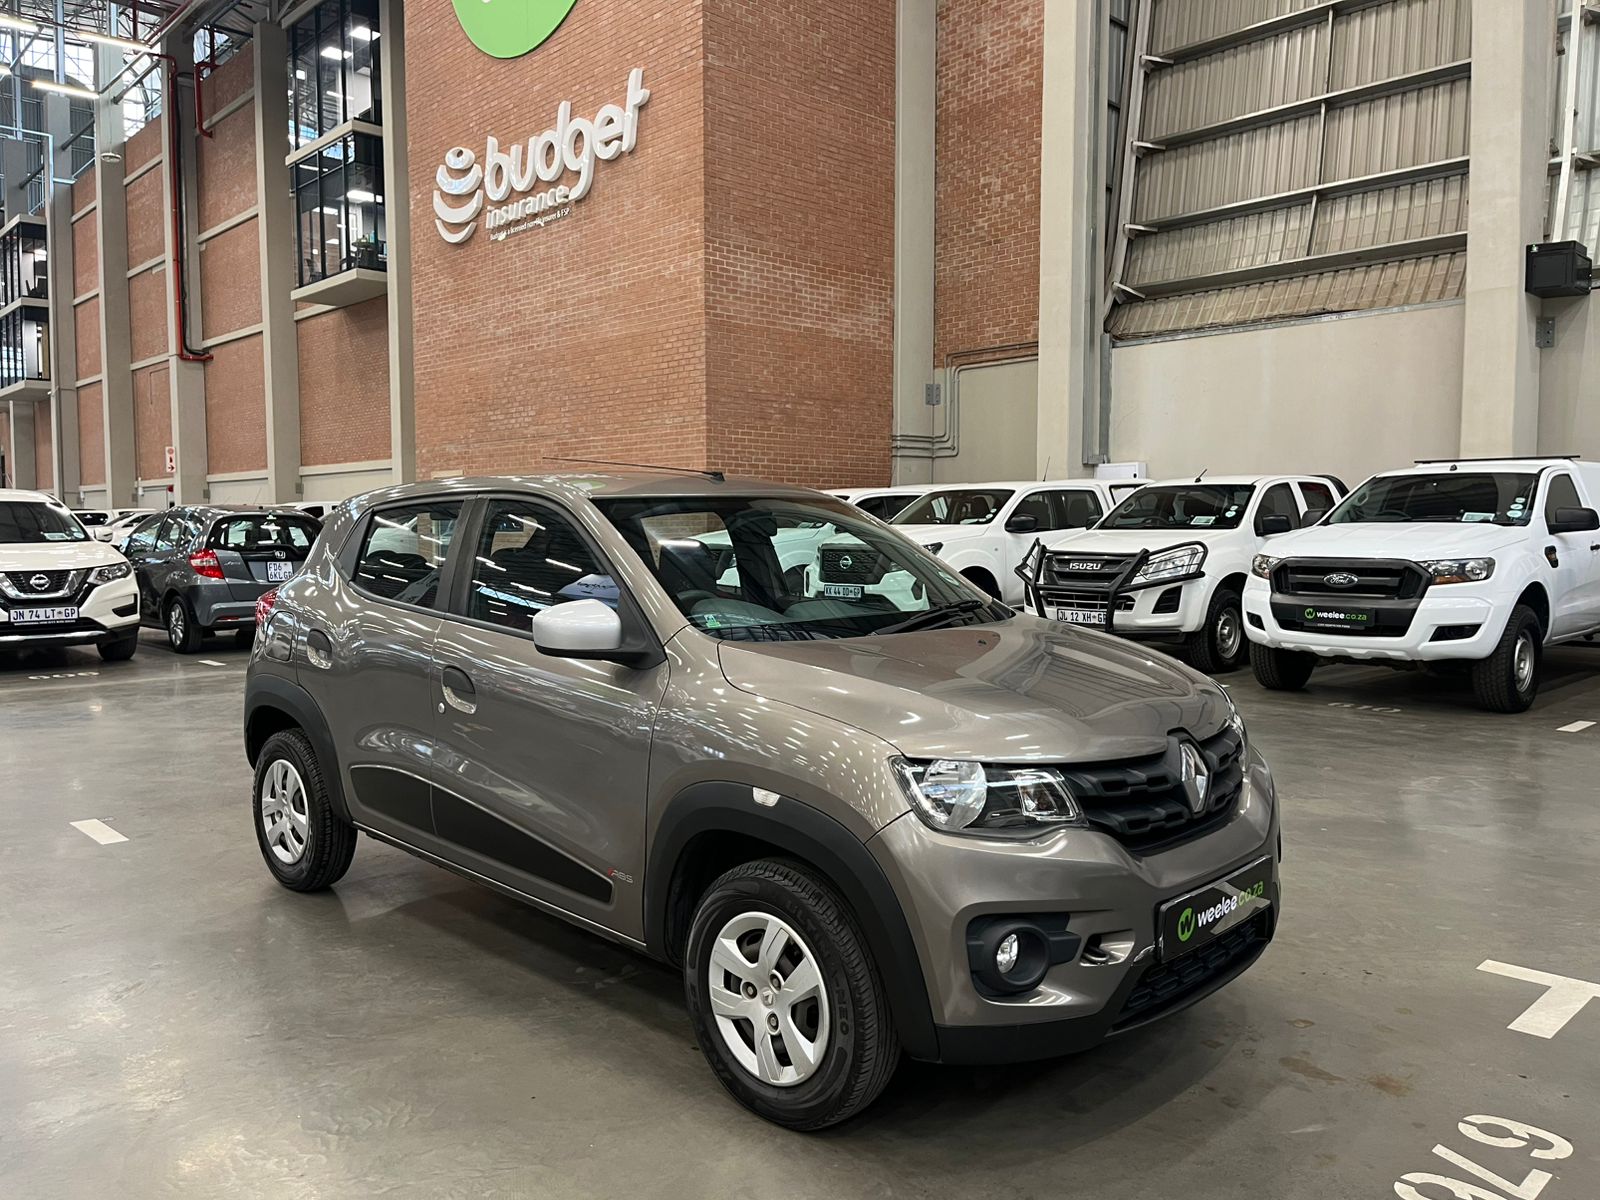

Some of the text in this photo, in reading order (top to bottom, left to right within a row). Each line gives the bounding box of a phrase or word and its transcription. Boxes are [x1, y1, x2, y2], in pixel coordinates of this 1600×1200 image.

[484, 68, 650, 202] budget
[486, 185, 570, 229] insurance
[1069, 562, 1102, 571] ISUZU
[1330, 575, 1350, 584] Ford
[834, 587, 841, 595] 44
[13, 608, 76, 621] JN 74 LT GP
[1060, 612, 1068, 621] JL
[1070, 612, 1079, 622] 12
[1082, 612, 1092, 622] XH
